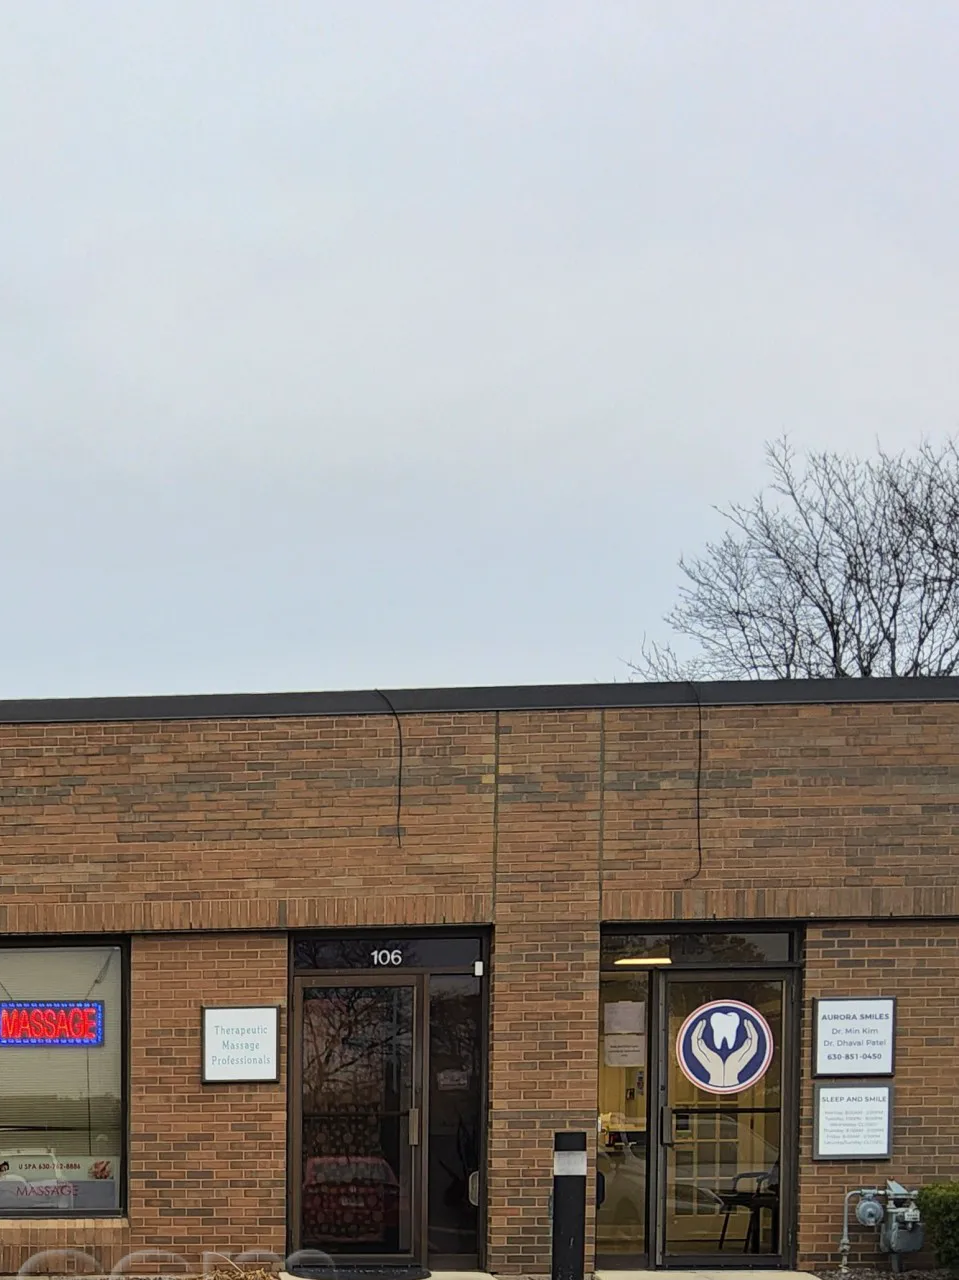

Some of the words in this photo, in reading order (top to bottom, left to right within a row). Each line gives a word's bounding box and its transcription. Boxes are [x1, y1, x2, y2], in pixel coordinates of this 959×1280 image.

[370, 949, 403, 966] 106
[821, 1013, 858, 1021] AURORA
[859, 1012, 890, 1020] SMILES
[1, 1007, 97, 1039] MASSAGE
[214, 1025, 268, 1036] Therapeutic
[831, 1027, 843, 1035] Dr.
[845, 1027, 860, 1035] Min
[862, 1026, 879, 1035] Kim
[222, 1040, 260, 1051] Massage
[823, 1039, 835, 1047] Dr.
[837, 1039, 864, 1047] Dhaval
[866, 1038, 887, 1046] Patel
[211, 1055, 271, 1065] Professionals
[16, 1184, 79, 1197] MASSAGE
